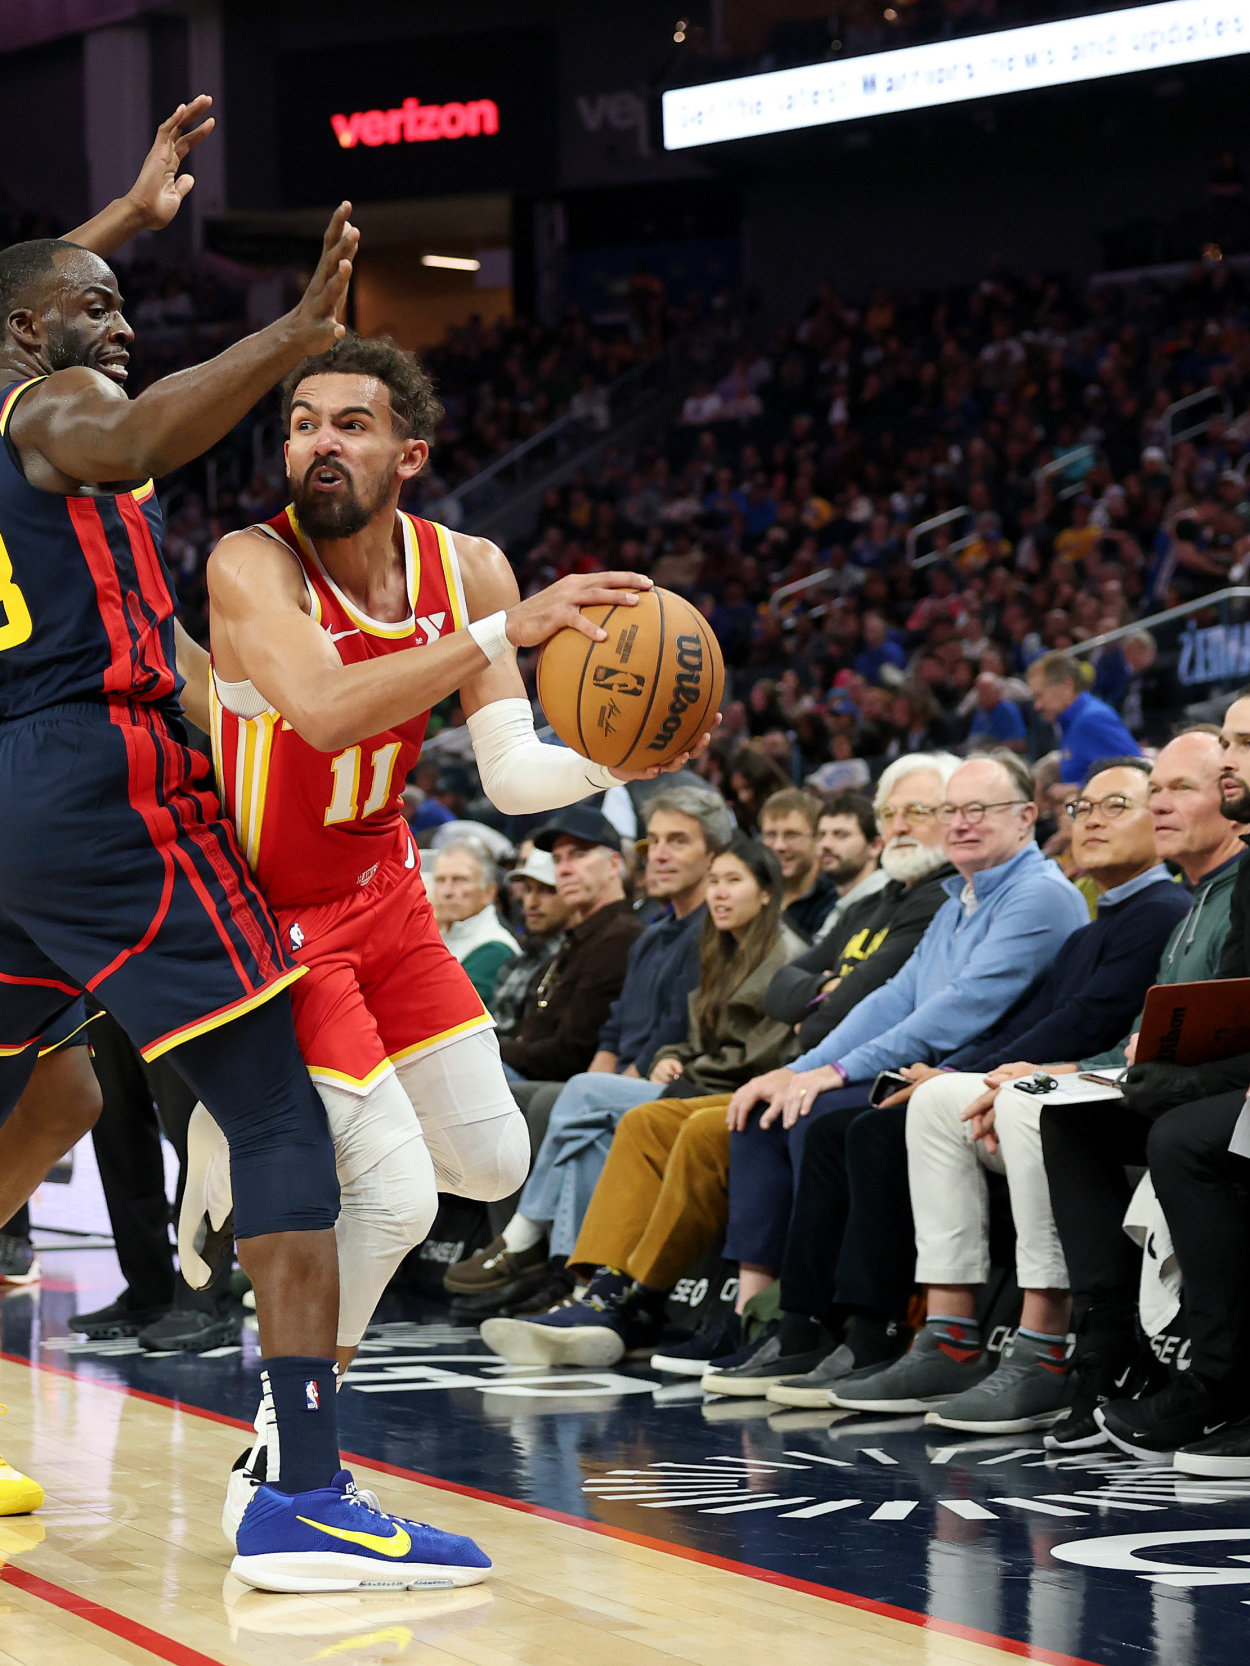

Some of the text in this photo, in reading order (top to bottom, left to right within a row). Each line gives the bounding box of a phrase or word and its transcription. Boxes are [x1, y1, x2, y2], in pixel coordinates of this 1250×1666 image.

[330, 97, 499, 148] verizon
[648, 633, 704, 752] Wilson
[323, 741, 403, 827] 11
